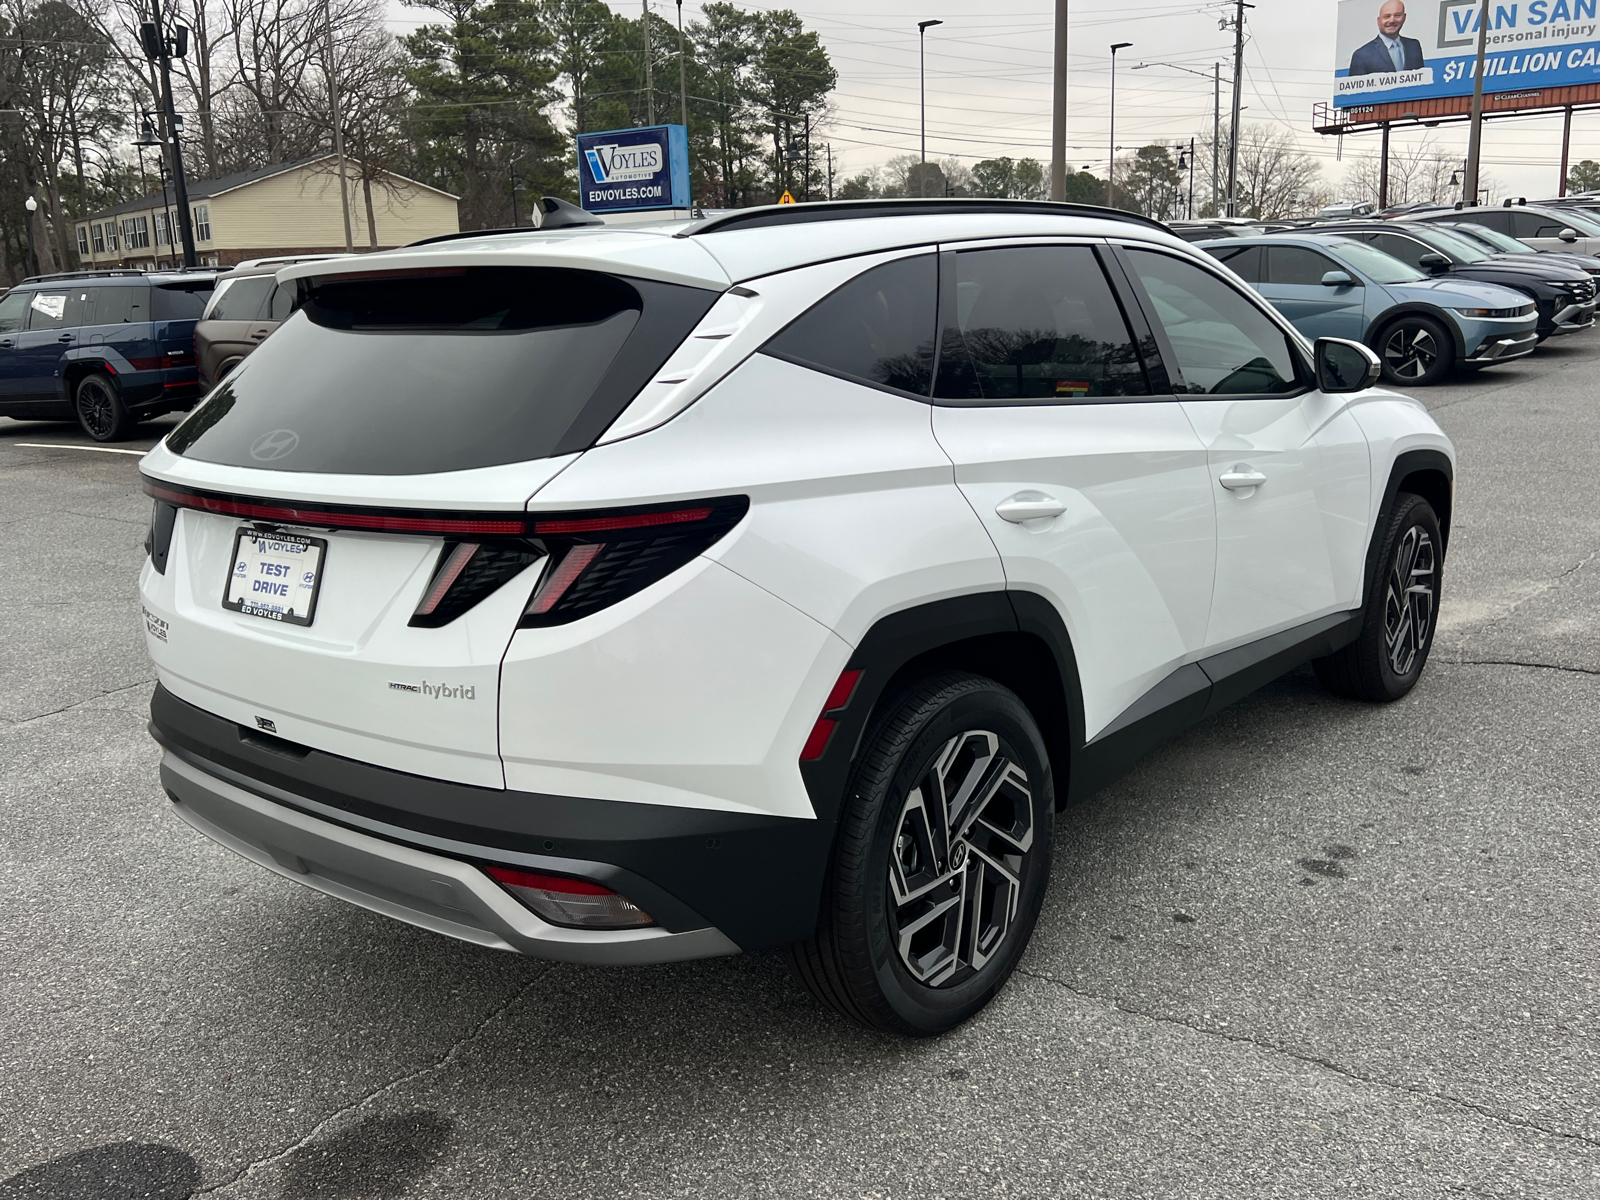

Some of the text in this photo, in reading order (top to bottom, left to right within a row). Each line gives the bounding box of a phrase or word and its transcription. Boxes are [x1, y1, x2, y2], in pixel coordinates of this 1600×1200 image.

[1452, 4, 1517, 34] VAN
[1551, 24, 1597, 39] injury
[1443, 60, 1467, 83] $1
[1469, 51, 1563, 78] MILLION
[1339, 73, 1424, 91] DAVID M. VAN SANT
[596, 147, 658, 178] VOYLES
[611, 172, 652, 181] AUTOMOTIVE
[589, 186, 662, 202] EDVOYLES.COM
[246, 529, 311, 544] WWW.EDVOYLES.COM
[268, 541, 302, 554] VOYLES
[260, 562, 290, 578] TEST
[252, 579, 289, 597] DRIVE
[241, 605, 252, 614] ED
[252, 607, 283, 621] VOYLES
[389, 680, 476, 700] HTRAC hybrid
